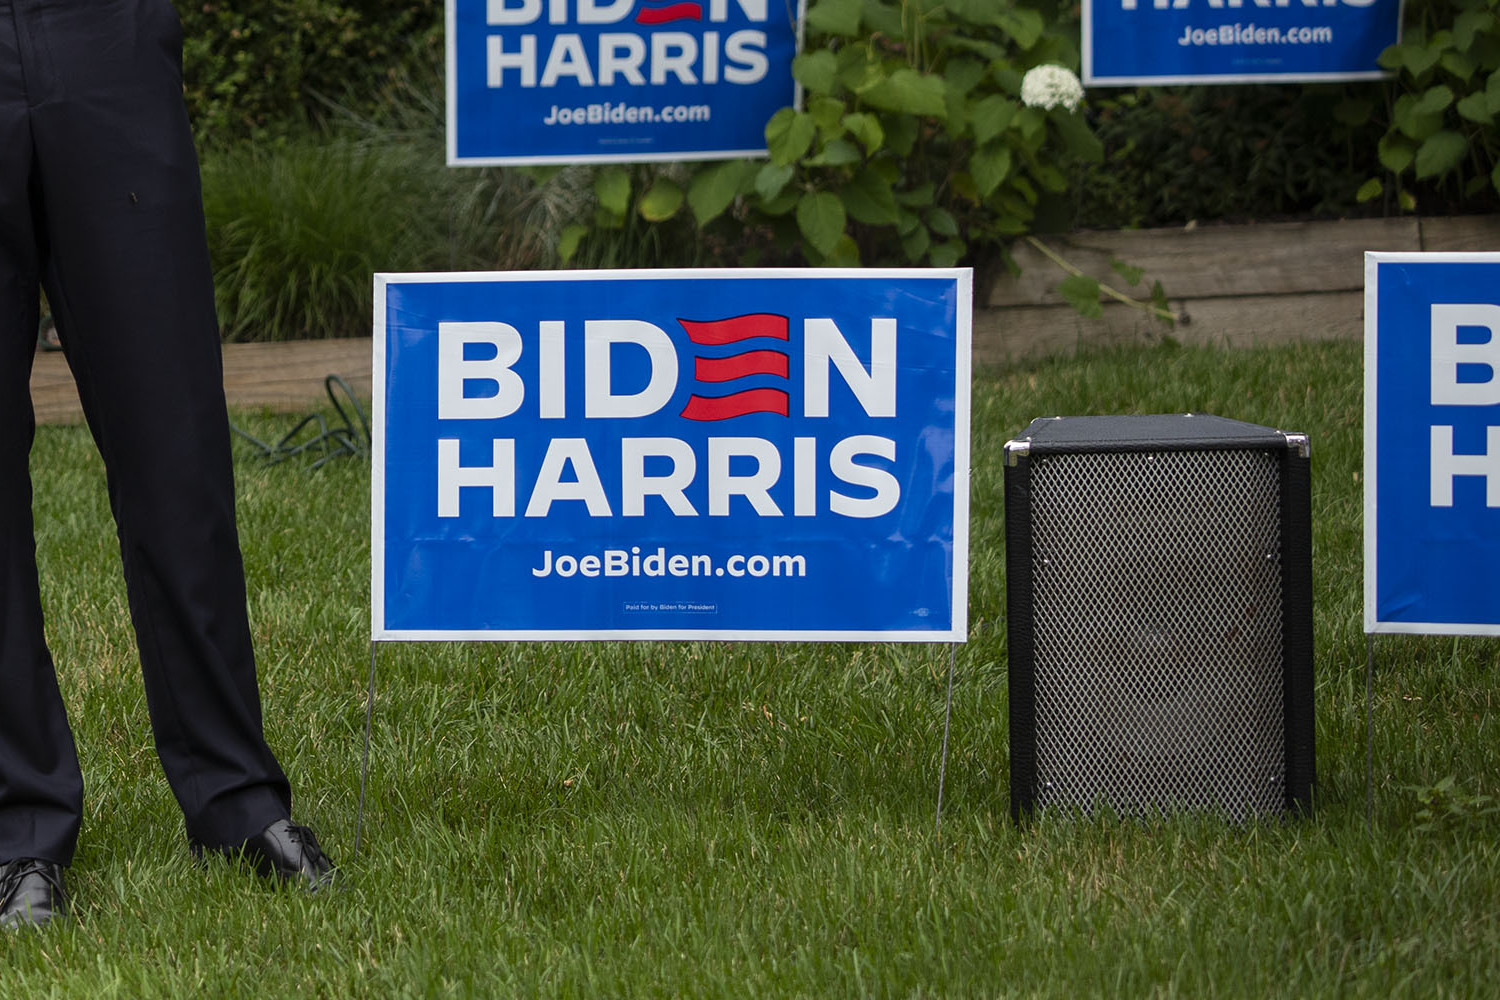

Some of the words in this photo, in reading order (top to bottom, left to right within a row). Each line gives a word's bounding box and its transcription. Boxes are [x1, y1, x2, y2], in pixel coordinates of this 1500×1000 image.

[1178, 23, 1333, 46] JoeBiden.com
[487, 30, 768, 86] HARRIS
[544, 103, 709, 125] JoeBiden.com
[438, 314, 897, 420] BIDEN
[438, 434, 901, 519] HARRIS
[532, 546, 806, 578] JoeBiden.com
[650, 604, 658, 612] by
